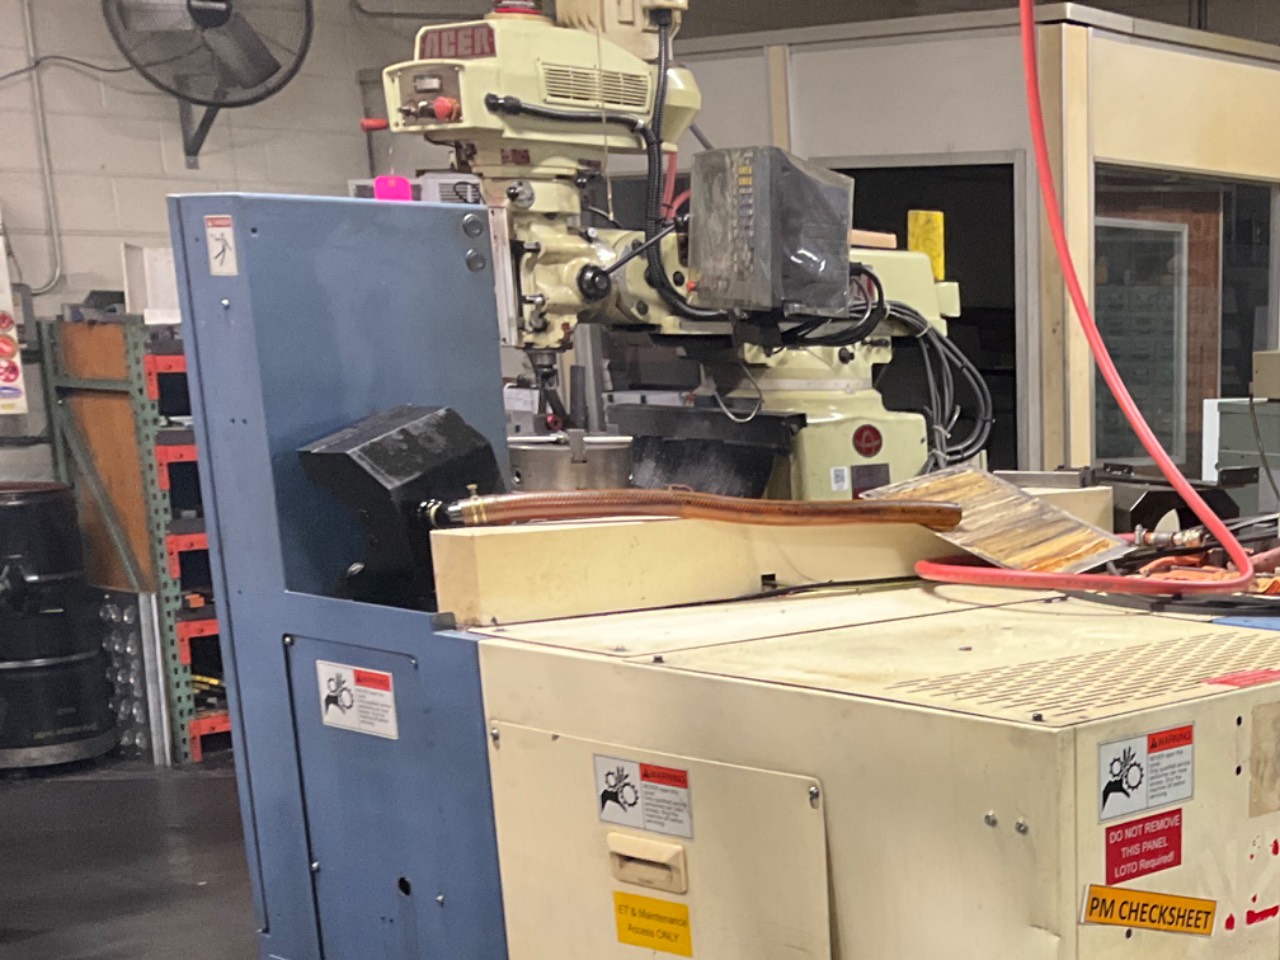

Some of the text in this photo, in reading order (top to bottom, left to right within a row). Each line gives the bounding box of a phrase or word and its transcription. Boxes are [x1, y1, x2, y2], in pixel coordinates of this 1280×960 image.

[423, 26, 491, 58] ACER
[1158, 731, 1192, 746] WARNING
[1109, 814, 1181, 844] DO NOT REMOVE
[1121, 836, 1169, 859] THIS PANEL
[1114, 850, 1176, 878] LOTO Required!
[617, 904, 688, 928] ET & Maintenance
[1088, 896, 1212, 930] PM CHECKSHEET
[627, 922, 680, 943] Access ONLY
